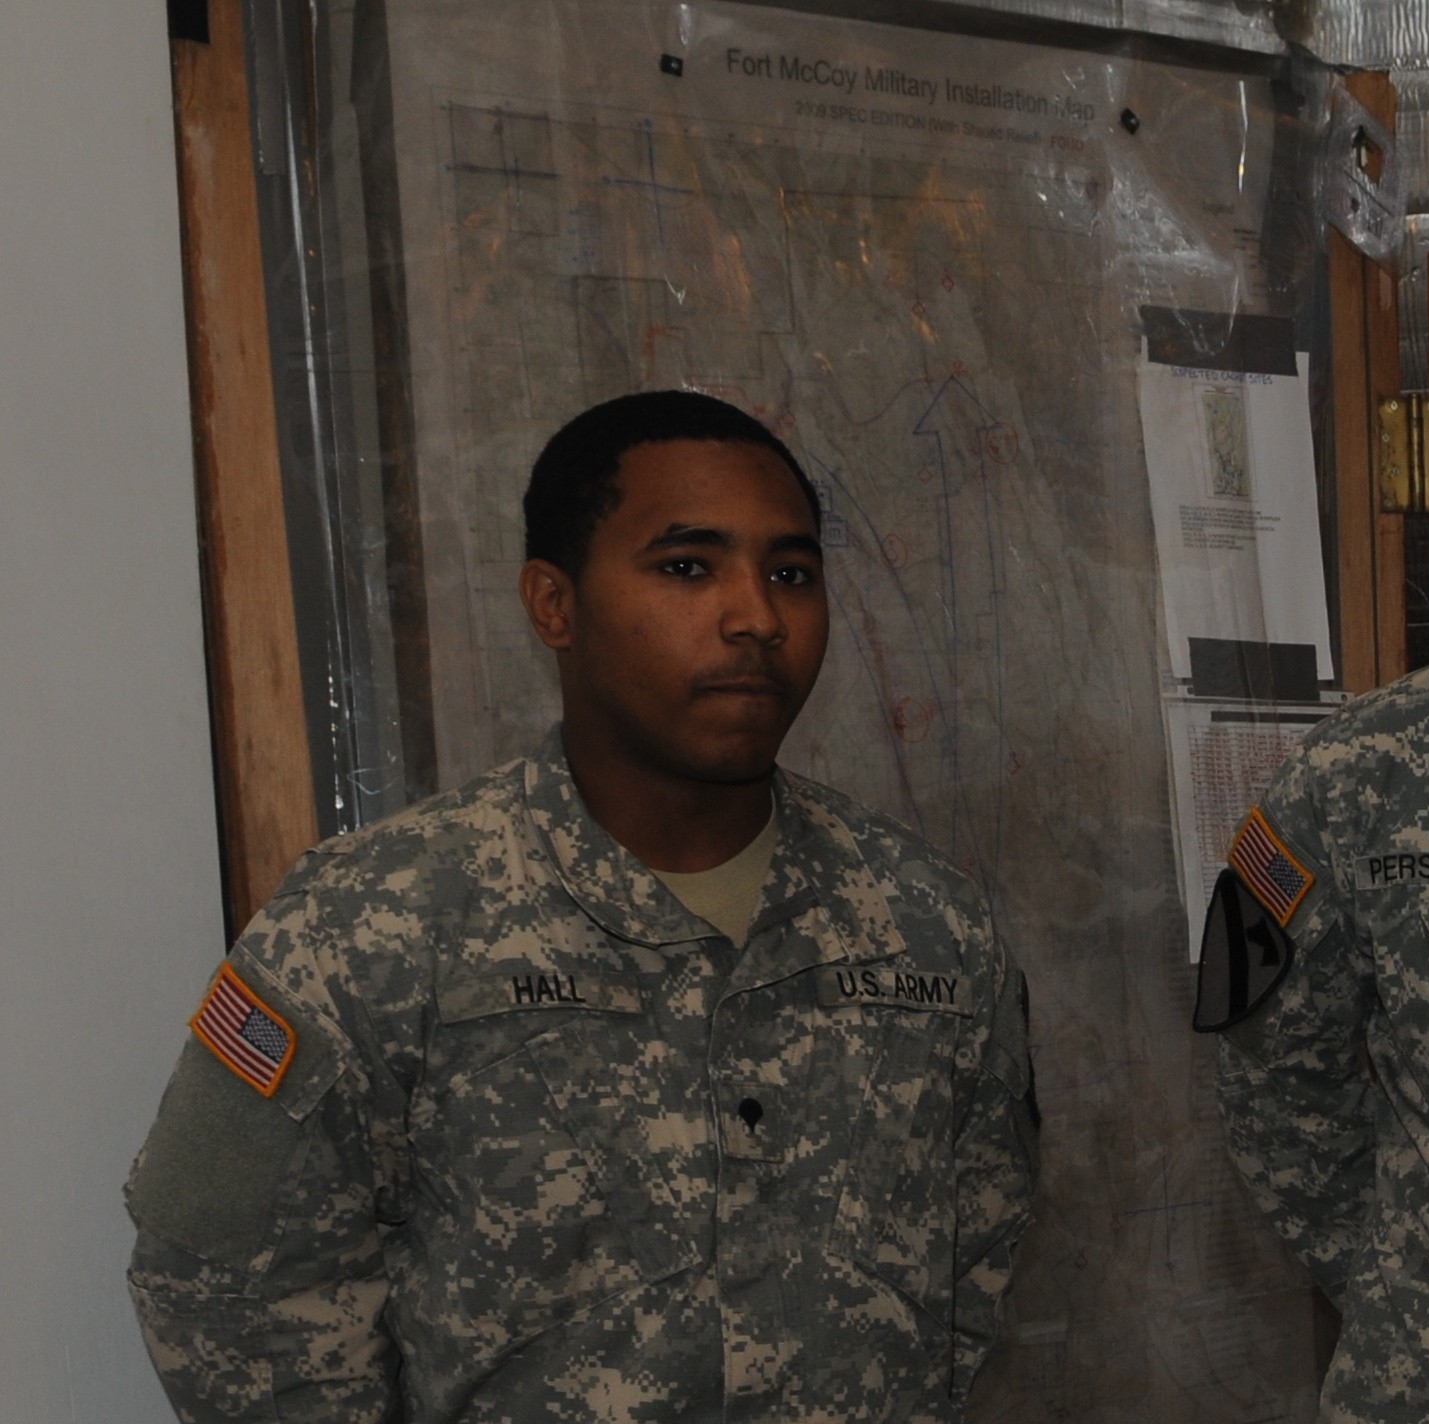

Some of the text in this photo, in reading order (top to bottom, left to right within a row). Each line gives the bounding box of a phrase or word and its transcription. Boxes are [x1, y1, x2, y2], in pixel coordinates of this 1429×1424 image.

[726, 49, 772, 78] Fort
[779, 55, 858, 94] McCoy
[864, 66, 939, 104] Military
[945, 78, 1048, 115] Installation
[512, 975, 585, 1004] HALL
[837, 970, 958, 1005] U.S. ARMY
